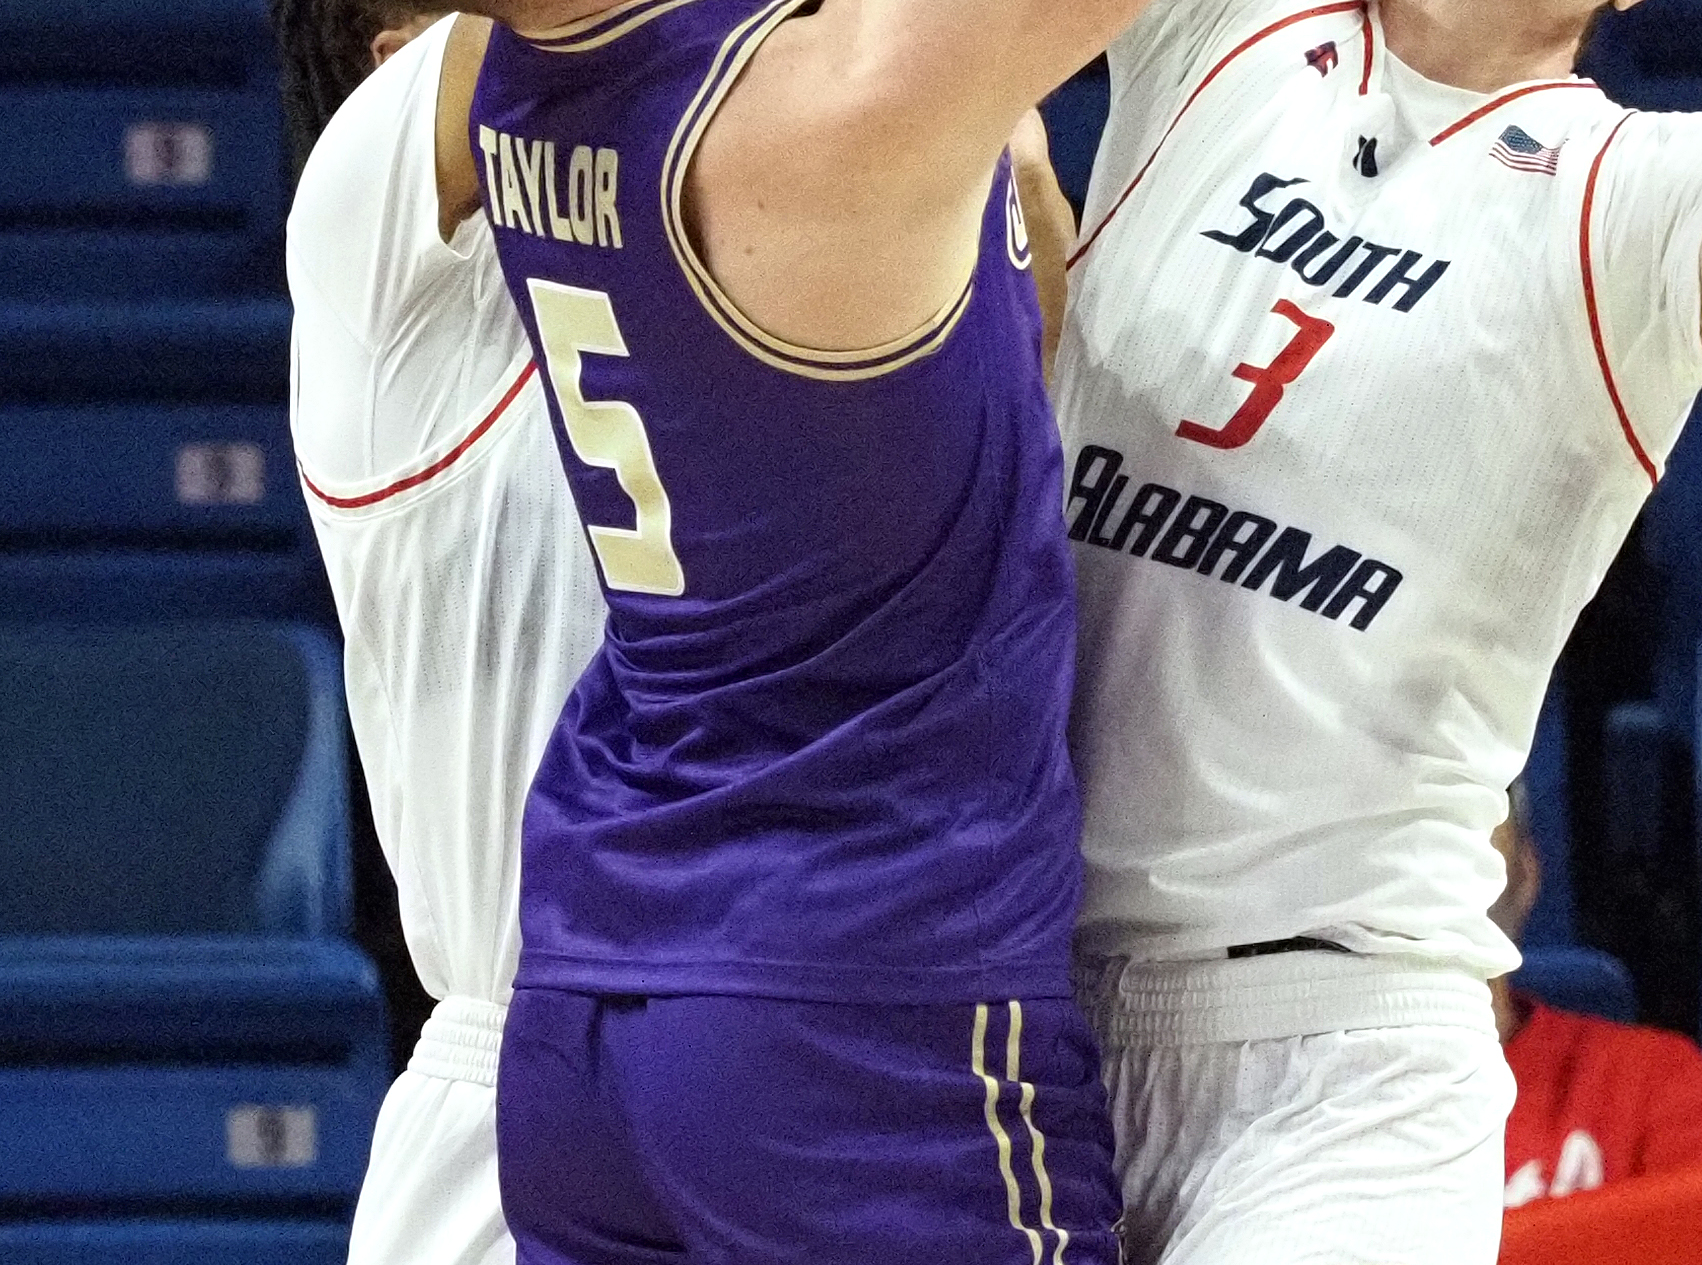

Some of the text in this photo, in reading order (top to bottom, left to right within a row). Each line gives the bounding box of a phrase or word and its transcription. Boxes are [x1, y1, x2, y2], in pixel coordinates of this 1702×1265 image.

[479, 124, 623, 249] TAYLOR
[1200, 172, 1452, 313] SOUTH
[526, 277, 686, 597] 5
[1174, 298, 1336, 450] 3
[1057, 444, 1403, 632] ALABAMA
